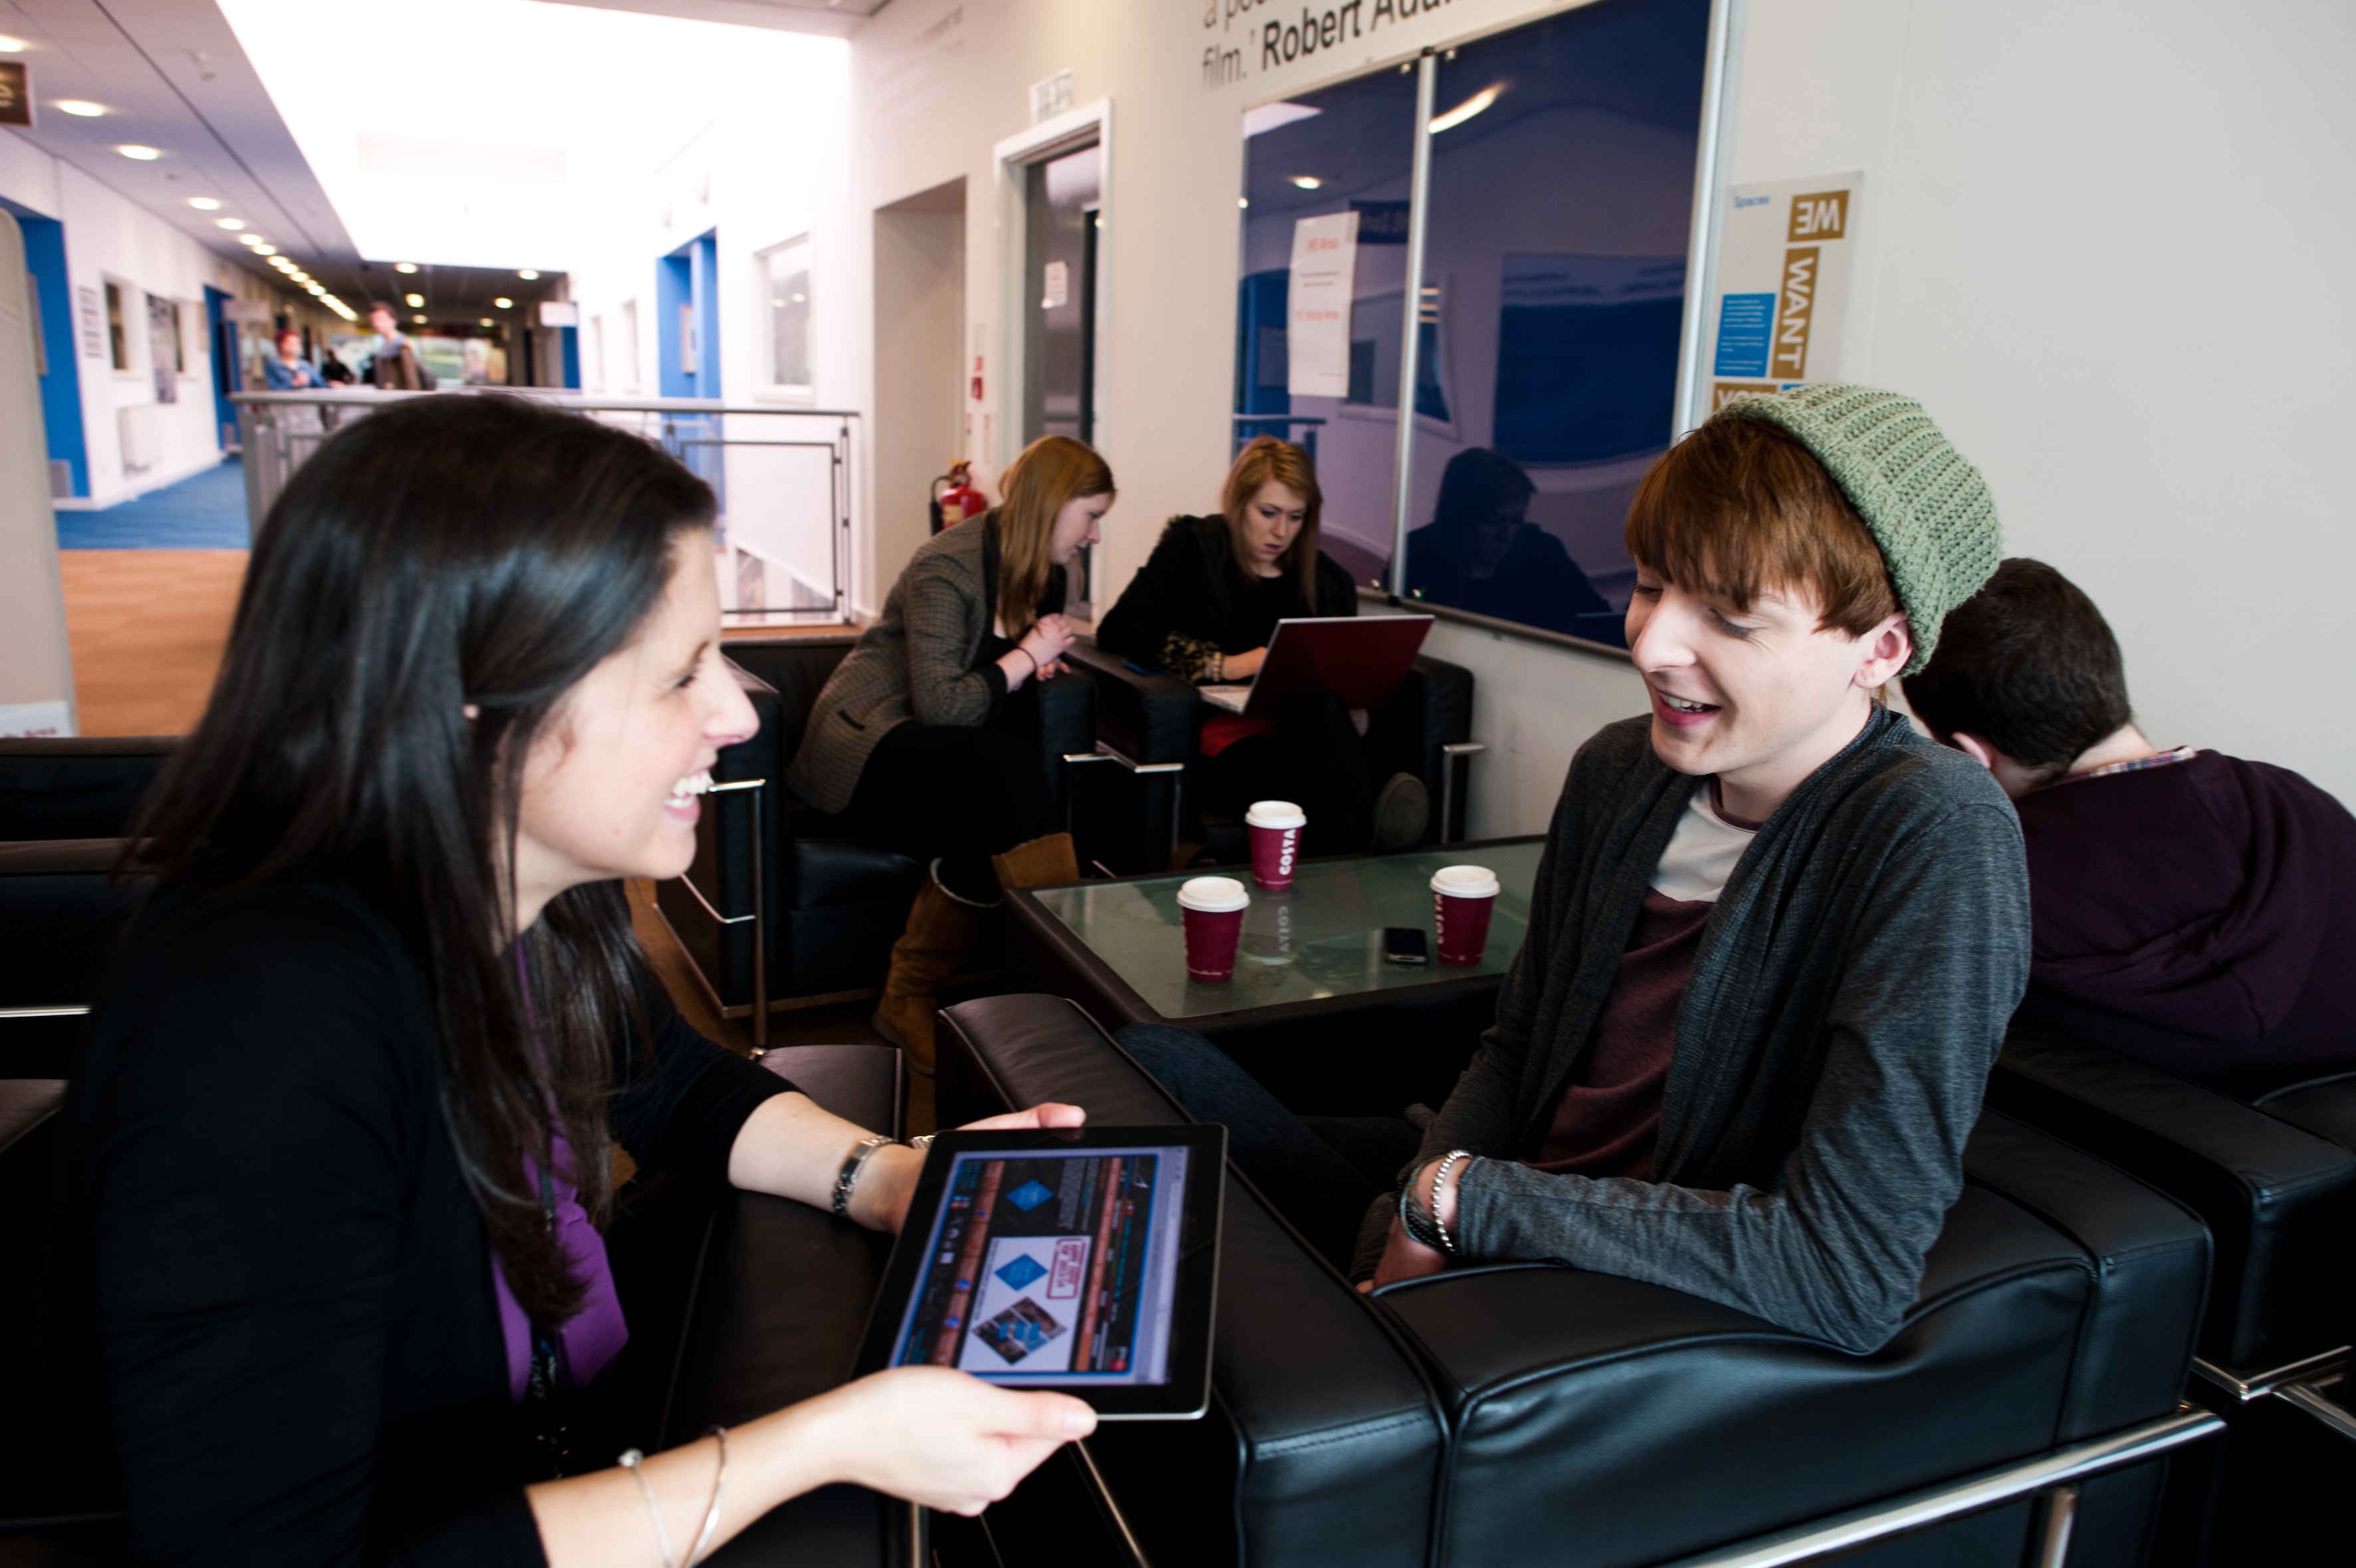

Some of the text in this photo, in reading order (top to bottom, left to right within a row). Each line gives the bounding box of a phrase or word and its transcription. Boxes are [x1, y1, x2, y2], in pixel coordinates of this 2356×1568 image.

[1262, 0, 1362, 71] Robert
[1794, 199, 1841, 234] WE
[1777, 257, 1814, 370] WANT
[1279, 829, 1297, 875] COSTA
